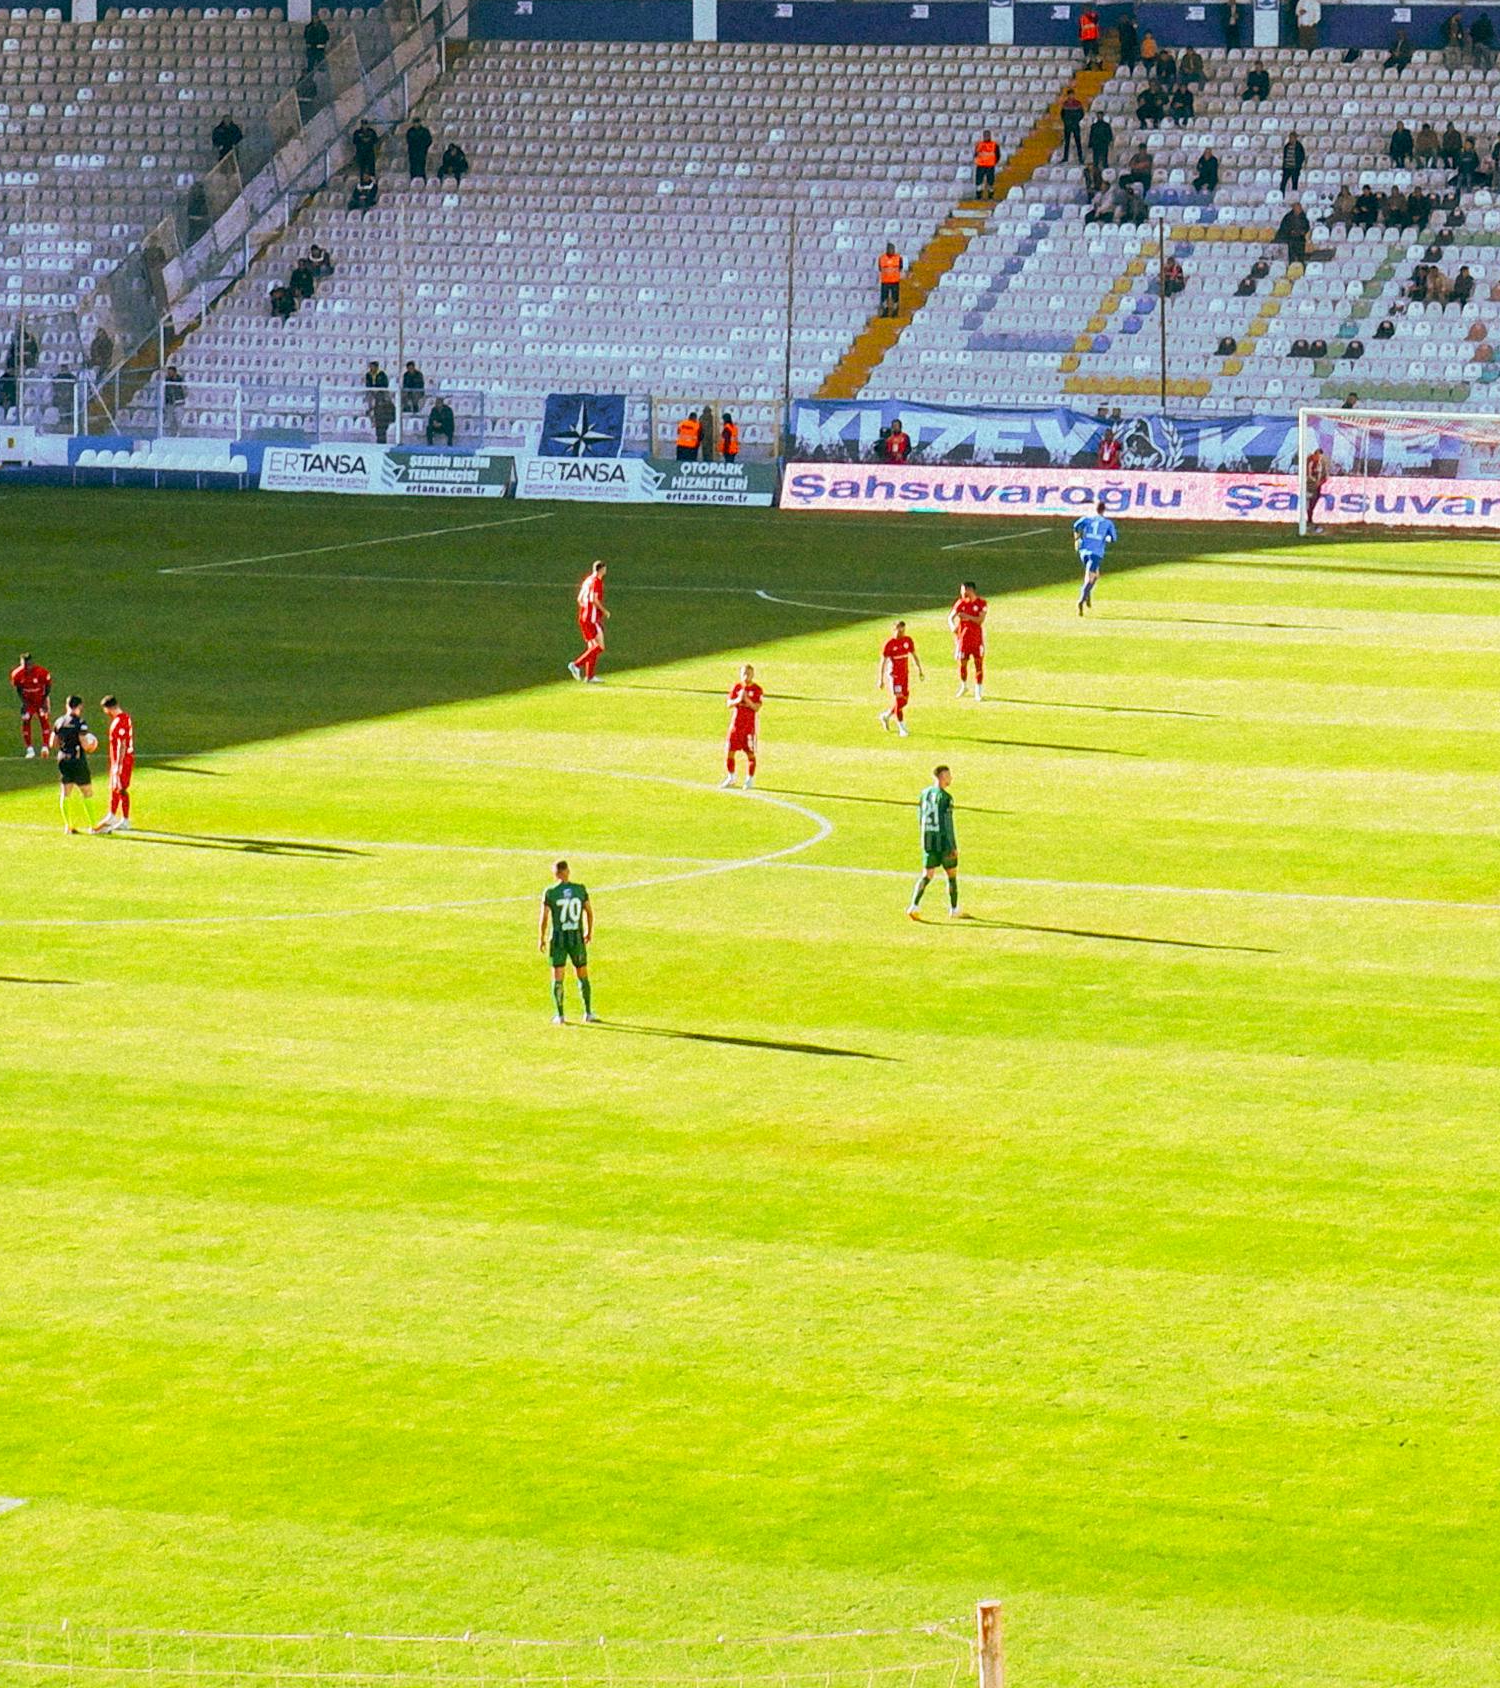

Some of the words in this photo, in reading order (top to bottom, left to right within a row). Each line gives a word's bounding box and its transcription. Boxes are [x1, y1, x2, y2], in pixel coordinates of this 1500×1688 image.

[269, 451, 367, 474] ERTANSA
[526, 460, 626, 483] ERTANSA
[680, 461, 743, 475] OTOPARK
[406, 484, 486, 495] ertansa.com.tr
[665, 492, 748, 503] ertansa.com.tr
[789, 474, 1183, 512] Şahsuvaroğlu
[555, 896, 582, 923] 70
